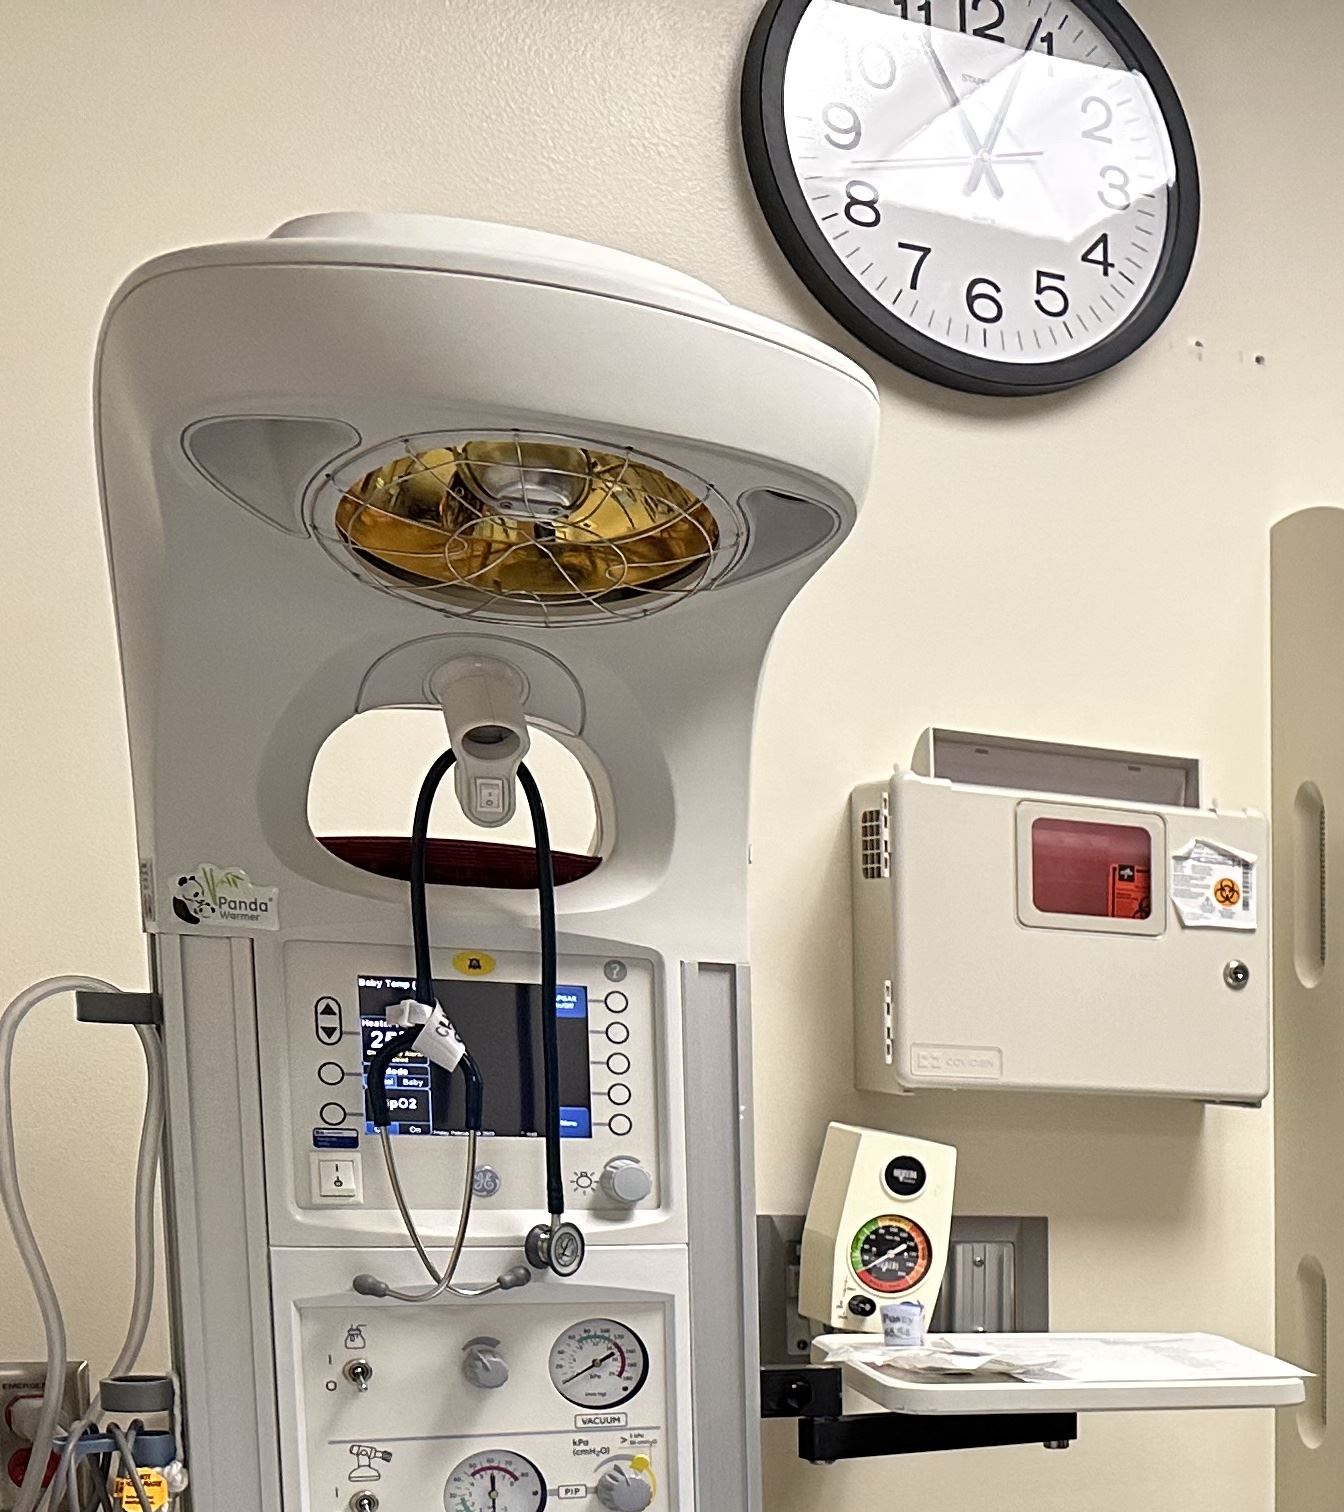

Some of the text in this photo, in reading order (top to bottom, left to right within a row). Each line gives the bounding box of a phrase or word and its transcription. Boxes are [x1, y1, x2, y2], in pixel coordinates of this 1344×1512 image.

[959, 0, 1005, 43] 12
[822, 102, 862, 150] 9
[1081, 96, 1113, 145] 2
[844, 179, 881, 228] 8
[1097, 165, 1131, 210] 3
[898, 242, 931, 290] 7
[1080, 233, 1115, 276] 4
[966, 277, 1003, 324] 6
[1034, 270, 1069, 317] 5
[218, 896, 269, 913] Panda
[220, 911, 261, 922] Warmer
[358, 978, 382, 989] Baby
[387, 1098, 417, 1110] pO2
[572, 1438, 589, 1446] kPa
[581, 1416, 621, 1425] VACUUM
